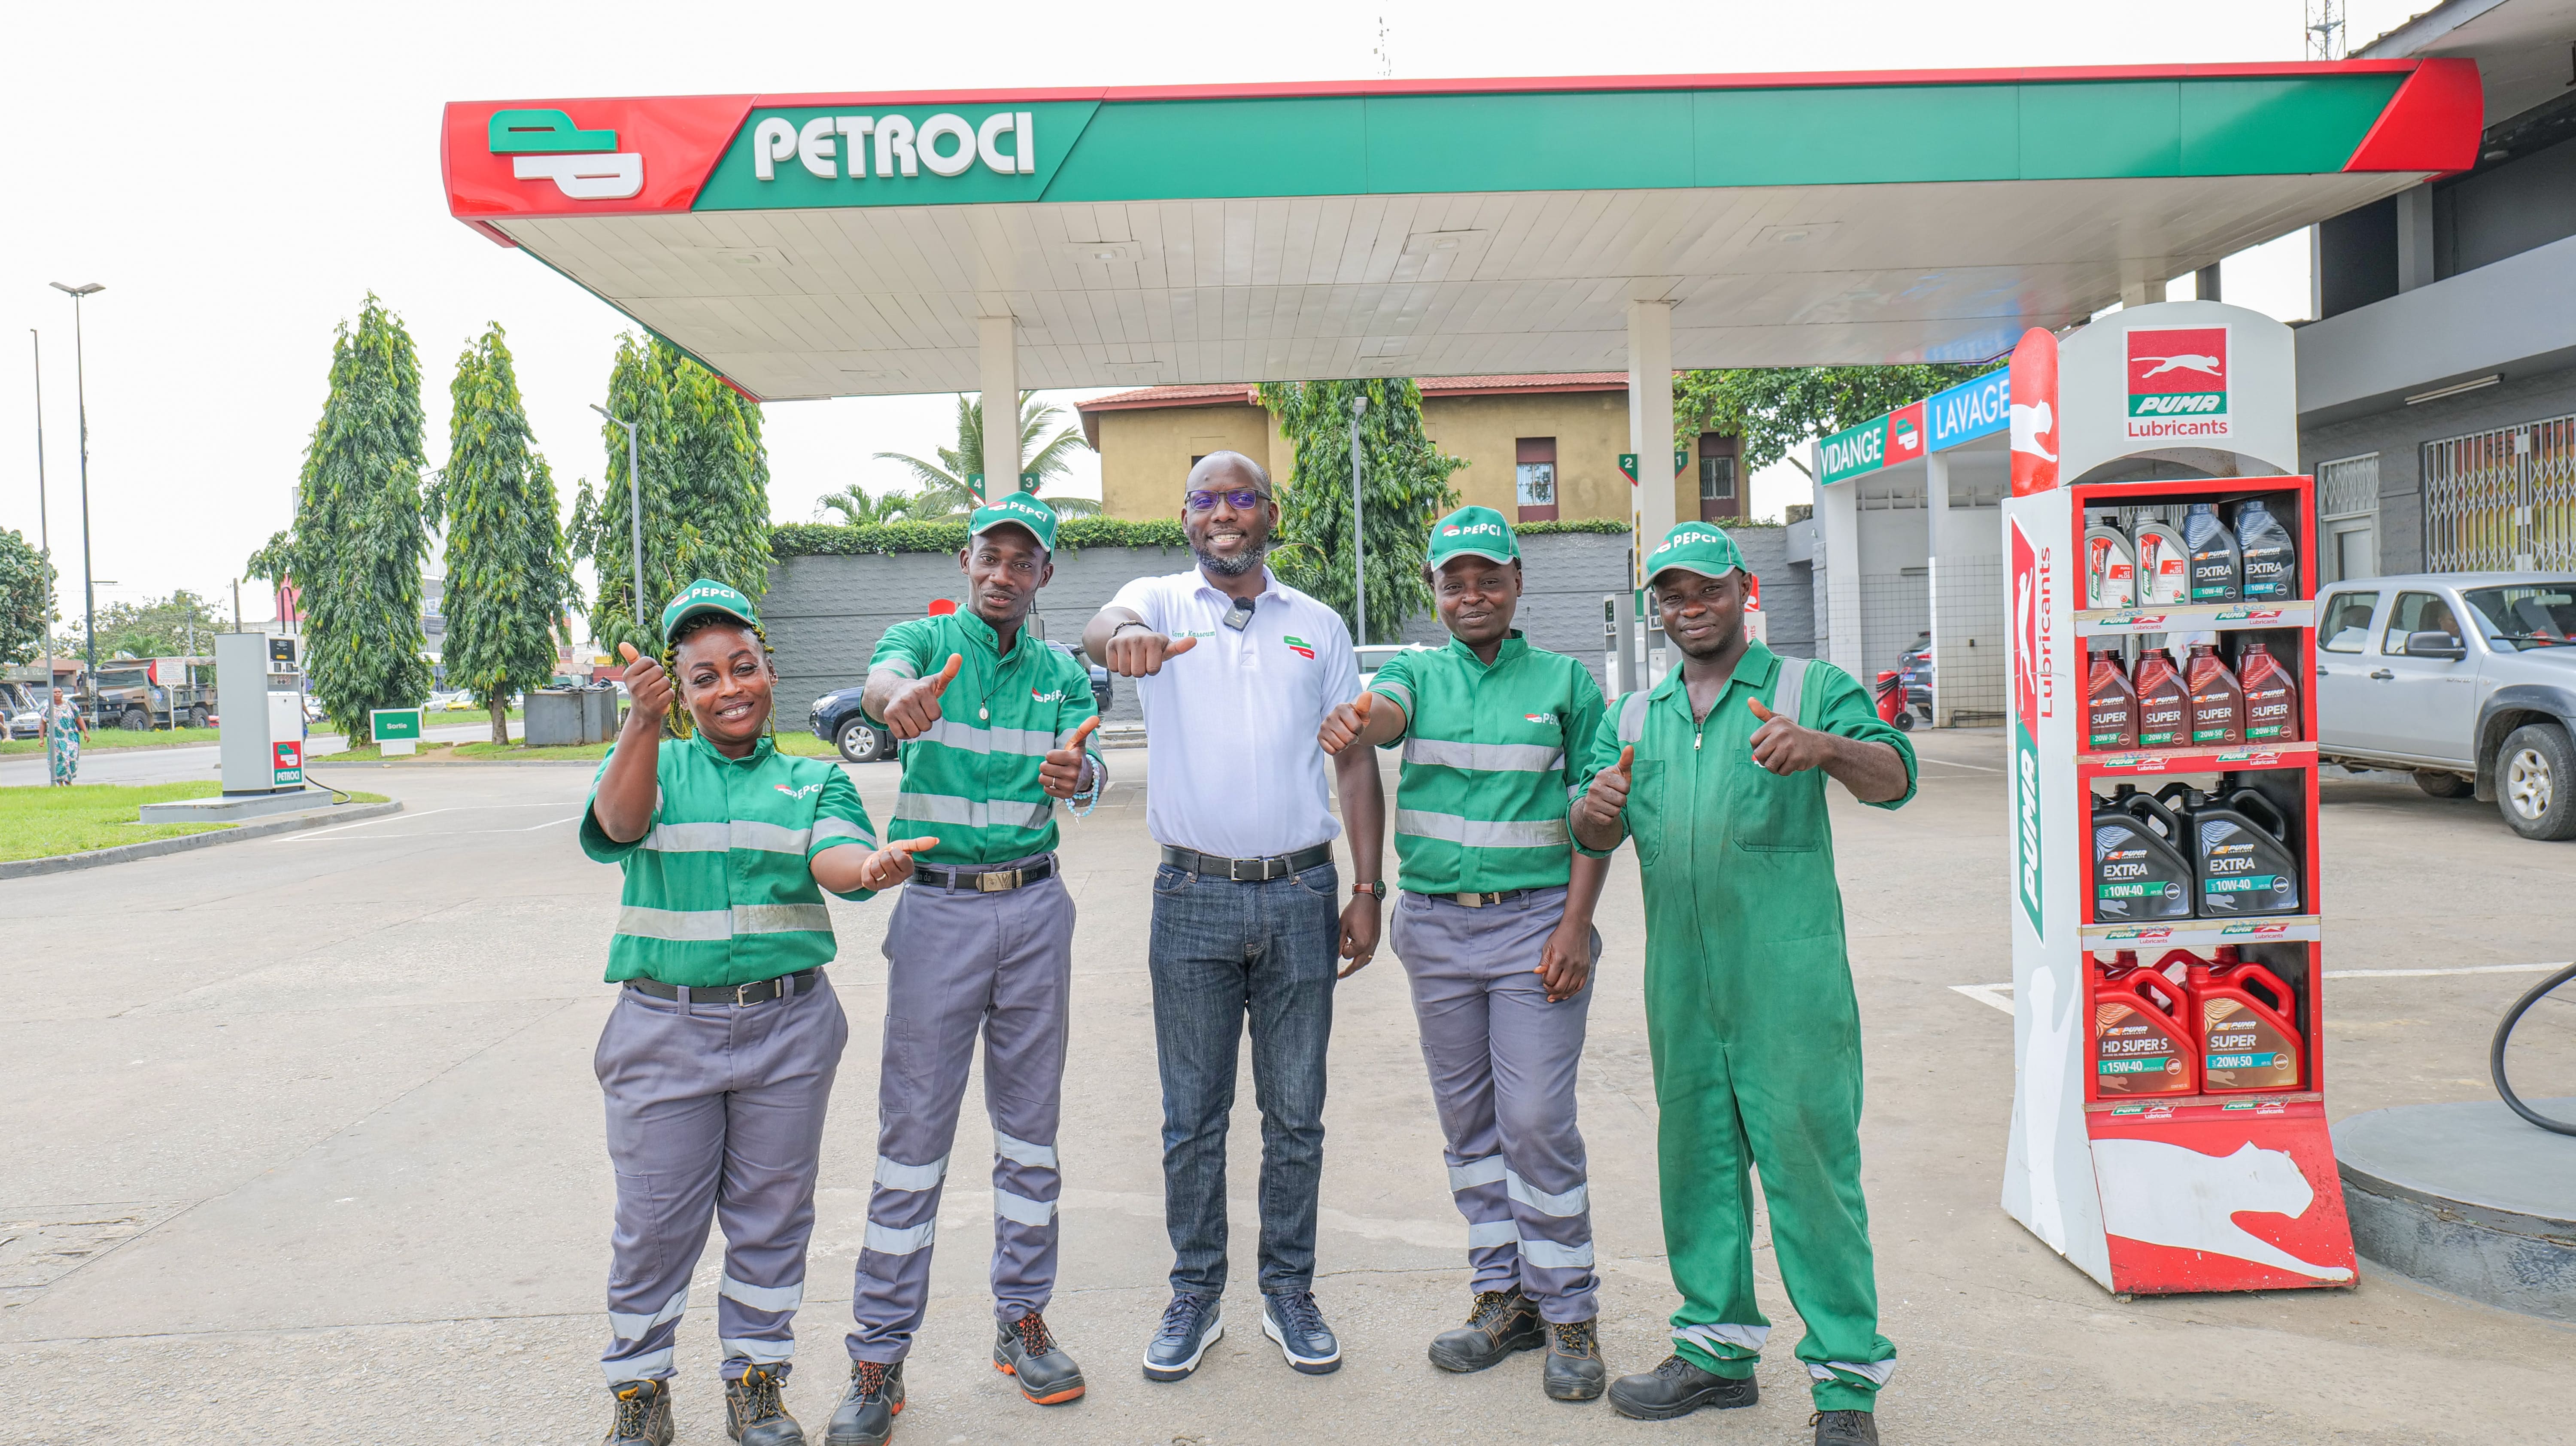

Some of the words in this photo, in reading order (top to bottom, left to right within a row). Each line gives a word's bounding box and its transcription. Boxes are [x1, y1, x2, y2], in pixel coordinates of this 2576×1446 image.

[755, 112, 1035, 181] PETROCI
[1936, 380, 2009, 440] LAVAGE
[2136, 395, 2220, 413] PUMA
[2129, 420, 2227, 437] Lubricants
[1820, 427, 1882, 477] VIDANGE
[1625, 458, 1633, 468] 2
[1676, 455, 1681, 465] 1
[974, 479, 982, 489] 4
[1026, 477, 1033, 488] 3
[1009, 501, 1048, 522] PEPCI
[1463, 523, 1500, 536] PEPCI
[1674, 532, 1716, 548] PEPCI
[2196, 565, 2233, 578] EXTRA
[2245, 562, 2283, 574] EXTRA
[692, 587, 735, 598] PEPCI
[2041, 547, 2052, 719] Lubricants
[2146, 711, 2181, 723] SUPER
[2197, 708, 2232, 720] SUPER
[2252, 704, 2288, 717] SUPER
[2092, 711, 2126, 724] SUPER
[277, 771, 300, 781] PETROCI
[2023, 748, 2038, 904] PUMA
[2103, 863, 2148, 877] EXTRA
[2210, 857, 2255, 871] EXTRA
[2109, 885, 2143, 896] 10W-40
[2216, 879, 2251, 891] 10W-40
[2102, 1041, 2121, 1053] HD
[2122, 1039, 2159, 1052] SUPER
[2161, 1038, 2168, 1050] S
[2210, 1034, 2257, 1048] SUPER
[2108, 1061, 2142, 1072] 15W-40
[2217, 1056, 2252, 1067] 20W-50
